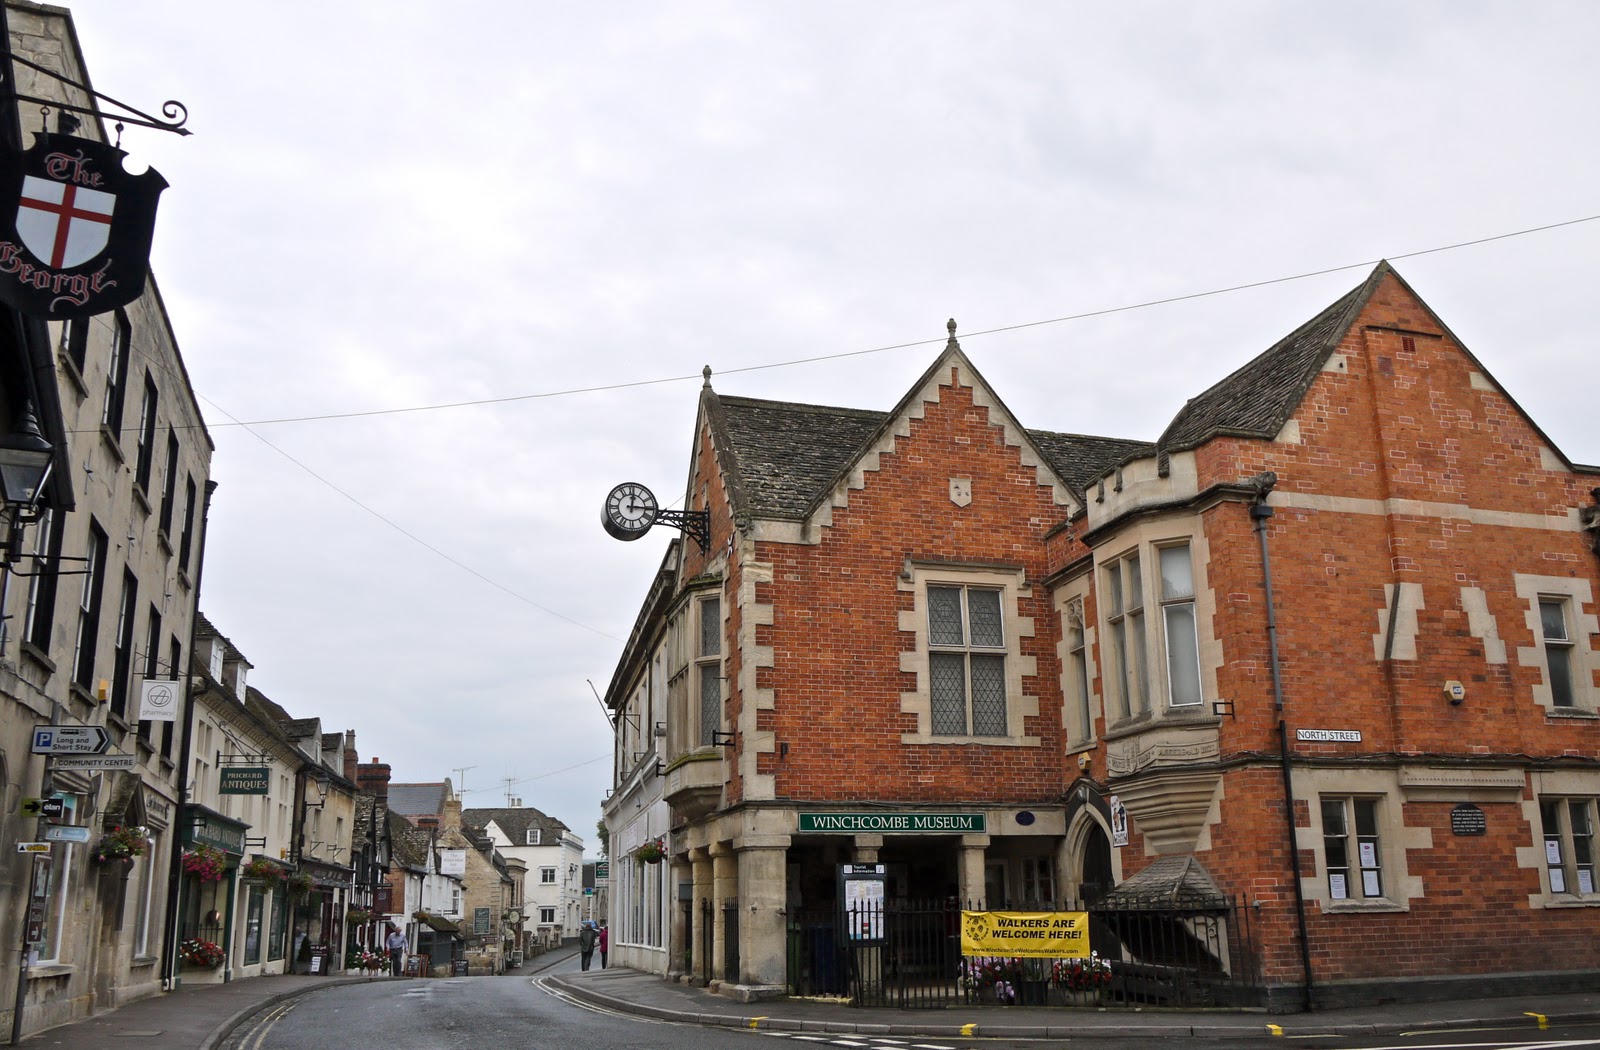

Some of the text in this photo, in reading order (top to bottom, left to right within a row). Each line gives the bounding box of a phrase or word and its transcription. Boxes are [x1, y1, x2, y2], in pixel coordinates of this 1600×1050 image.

[44, 149, 104, 187] The
[0, 241, 117, 312] George
[142, 709, 173, 718] pharmacy
[39, 733, 50, 746] P
[1298, 731, 1359, 740] NORTH STREET
[56, 737, 74, 745] Long
[75, 744, 92, 752] Stay
[222, 780, 268, 790] ANTIQUES
[813, 816, 972, 829] WINCHCOMBE MUSEUM
[998, 919, 1075, 928] WALKERS ARE
[992, 930, 1082, 939] WELCOME HERE!
